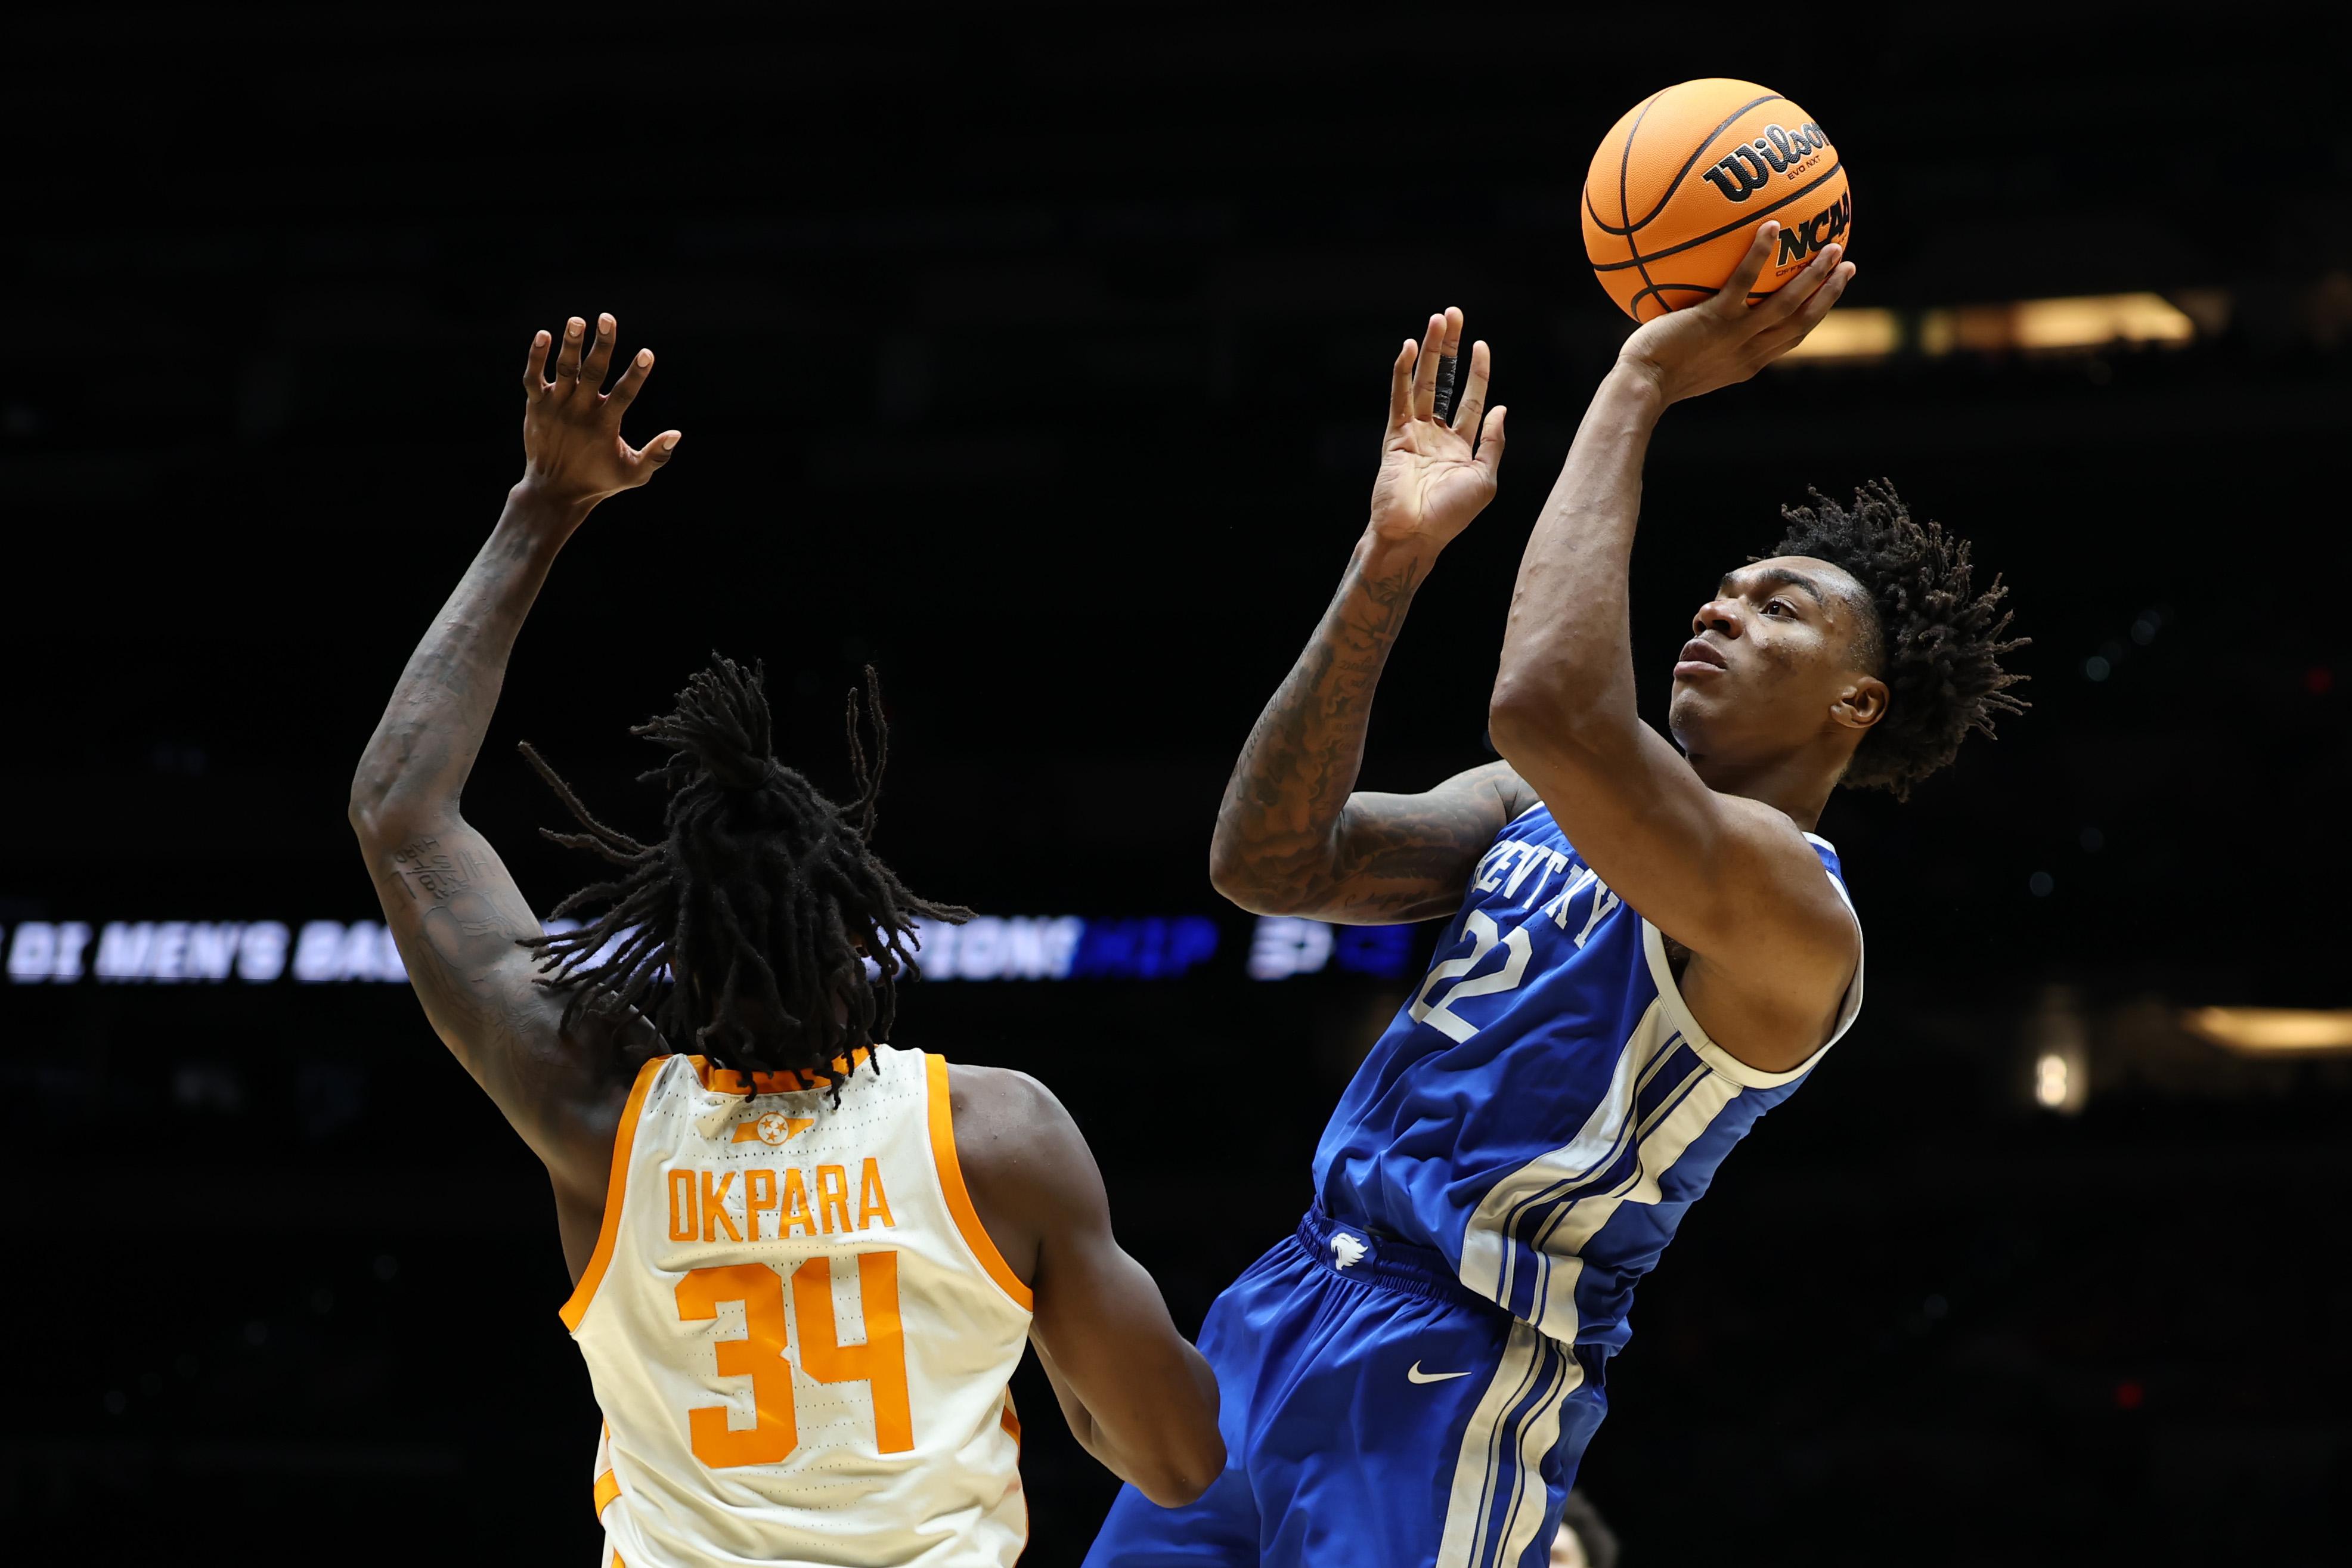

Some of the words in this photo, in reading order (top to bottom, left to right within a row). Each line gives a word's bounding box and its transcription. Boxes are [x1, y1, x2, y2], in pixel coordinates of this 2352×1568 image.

[1787, 165, 1805, 180] EVO
[1806, 154, 1820, 168] NXT
[95, 921, 289, 982] MEN'S
[1408, 909, 1533, 1044] 22
[668, 1157, 895, 1242] OKPARA
[674, 1250, 915, 1468] 34
